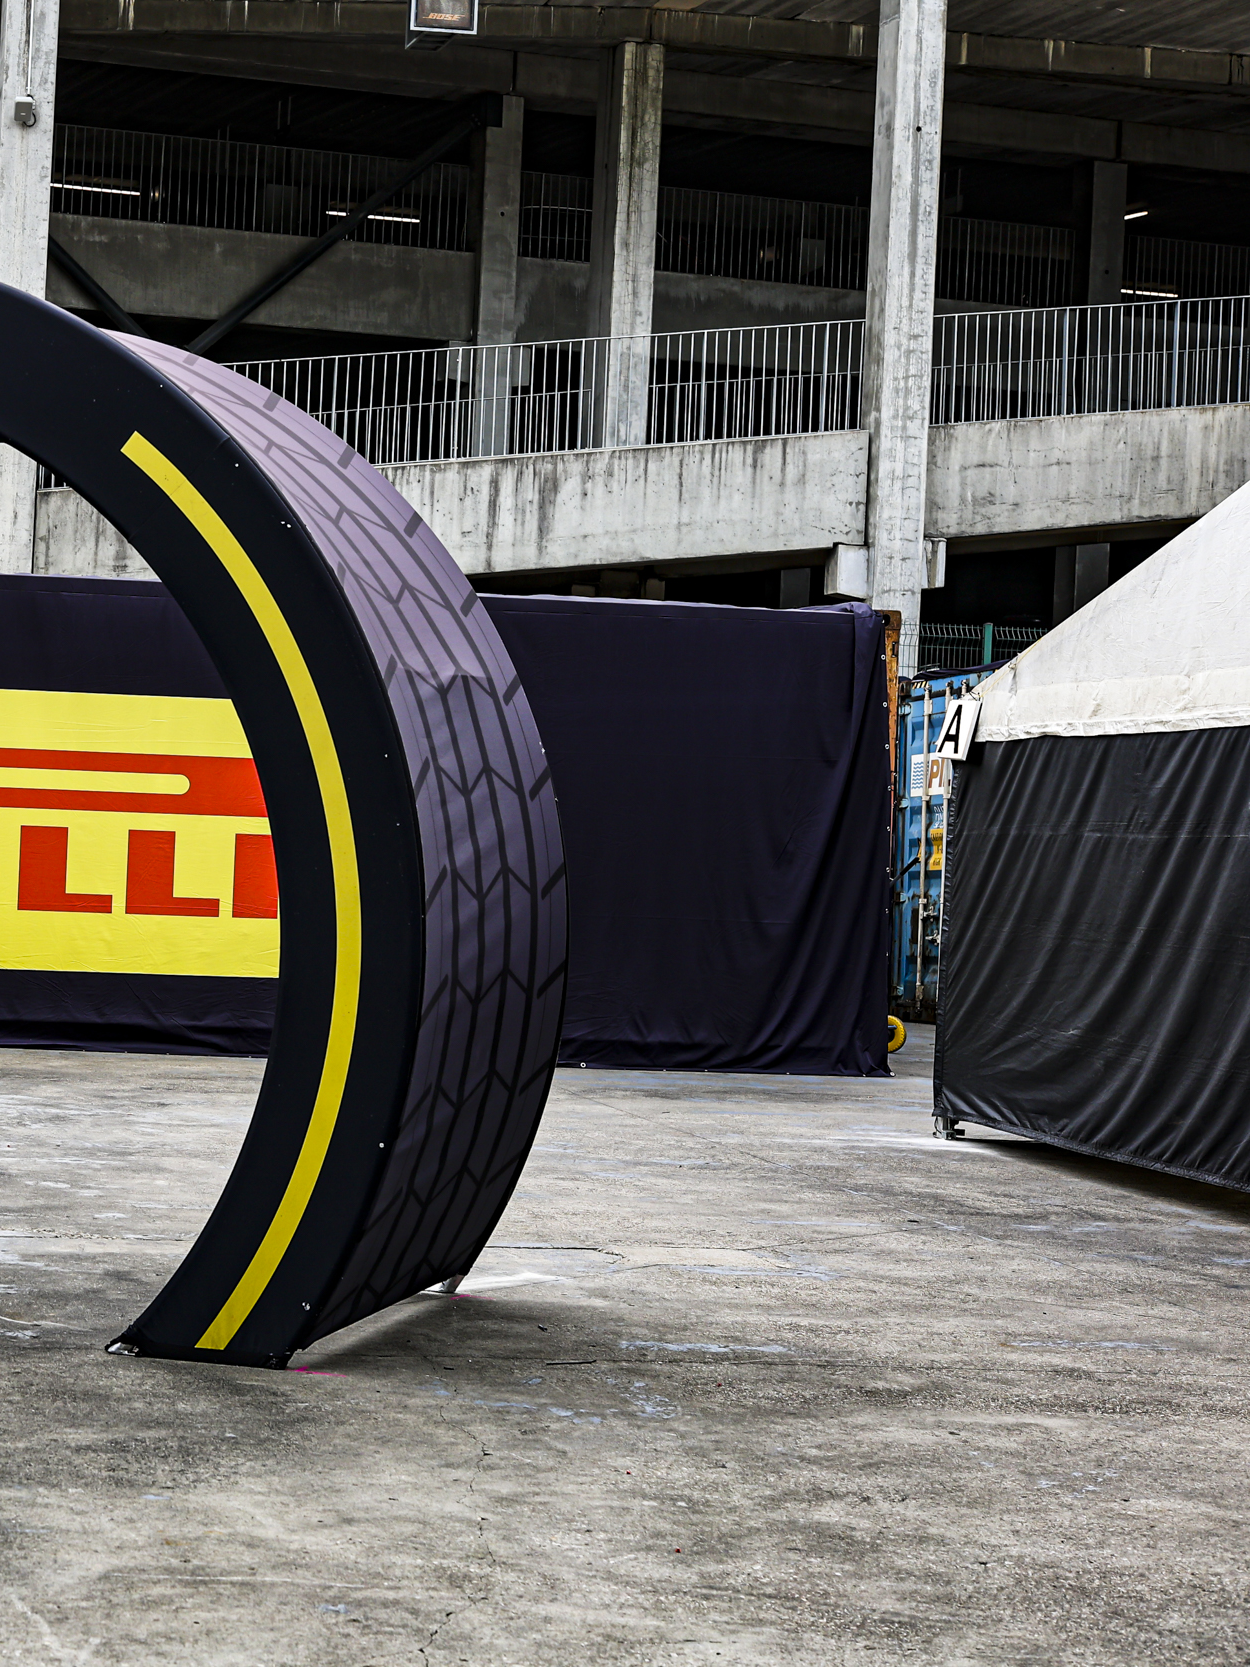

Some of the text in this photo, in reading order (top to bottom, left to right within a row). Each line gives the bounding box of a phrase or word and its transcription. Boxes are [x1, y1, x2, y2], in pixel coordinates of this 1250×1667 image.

[424, 12, 465, 21] BOSE
[937, 704, 963, 754] A
[928, 757, 950, 788] PI
